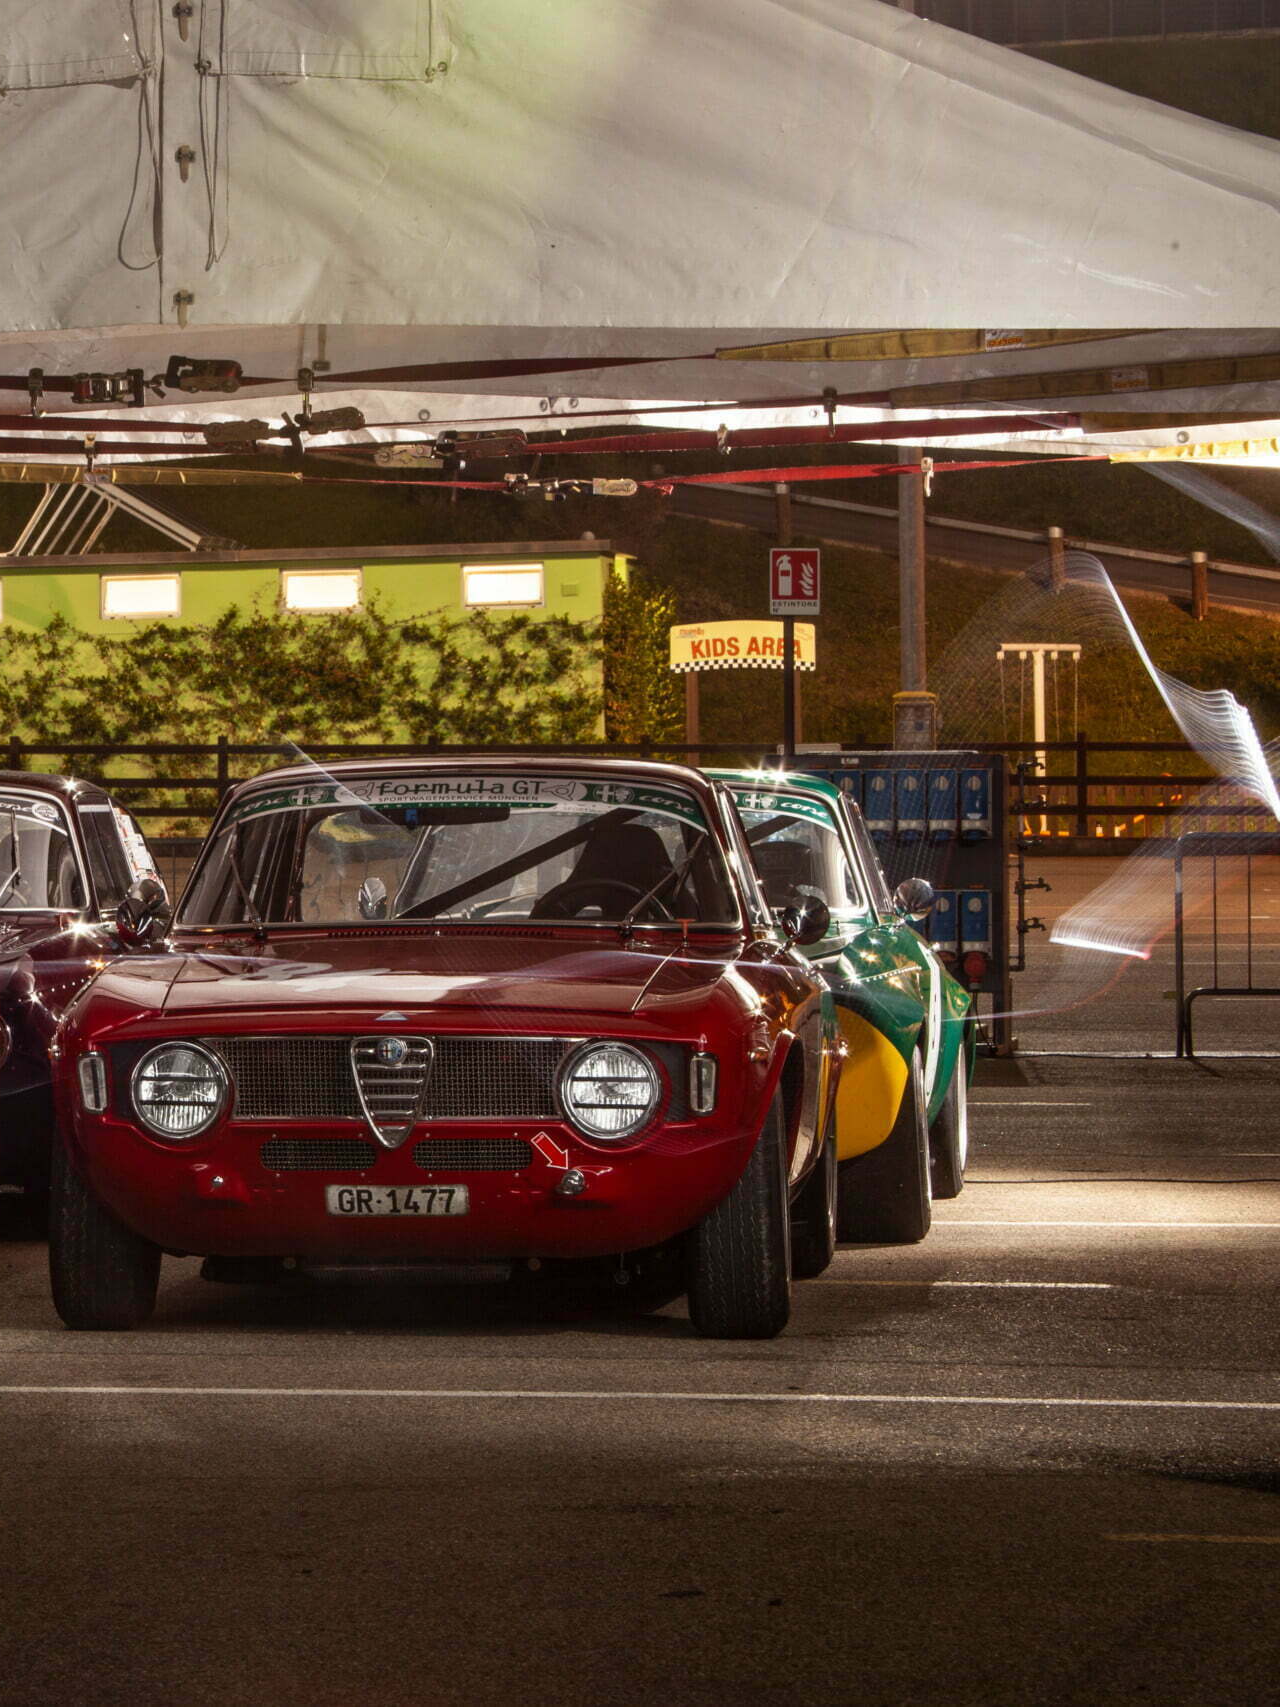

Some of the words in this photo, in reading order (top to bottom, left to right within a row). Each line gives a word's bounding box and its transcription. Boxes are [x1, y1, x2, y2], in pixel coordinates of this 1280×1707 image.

[691, 637, 740, 659] KIDS
[376, 780, 505, 796] formula
[512, 780, 547, 795] GT
[379, 795, 482, 803] SPORTWAGENSERVICE
